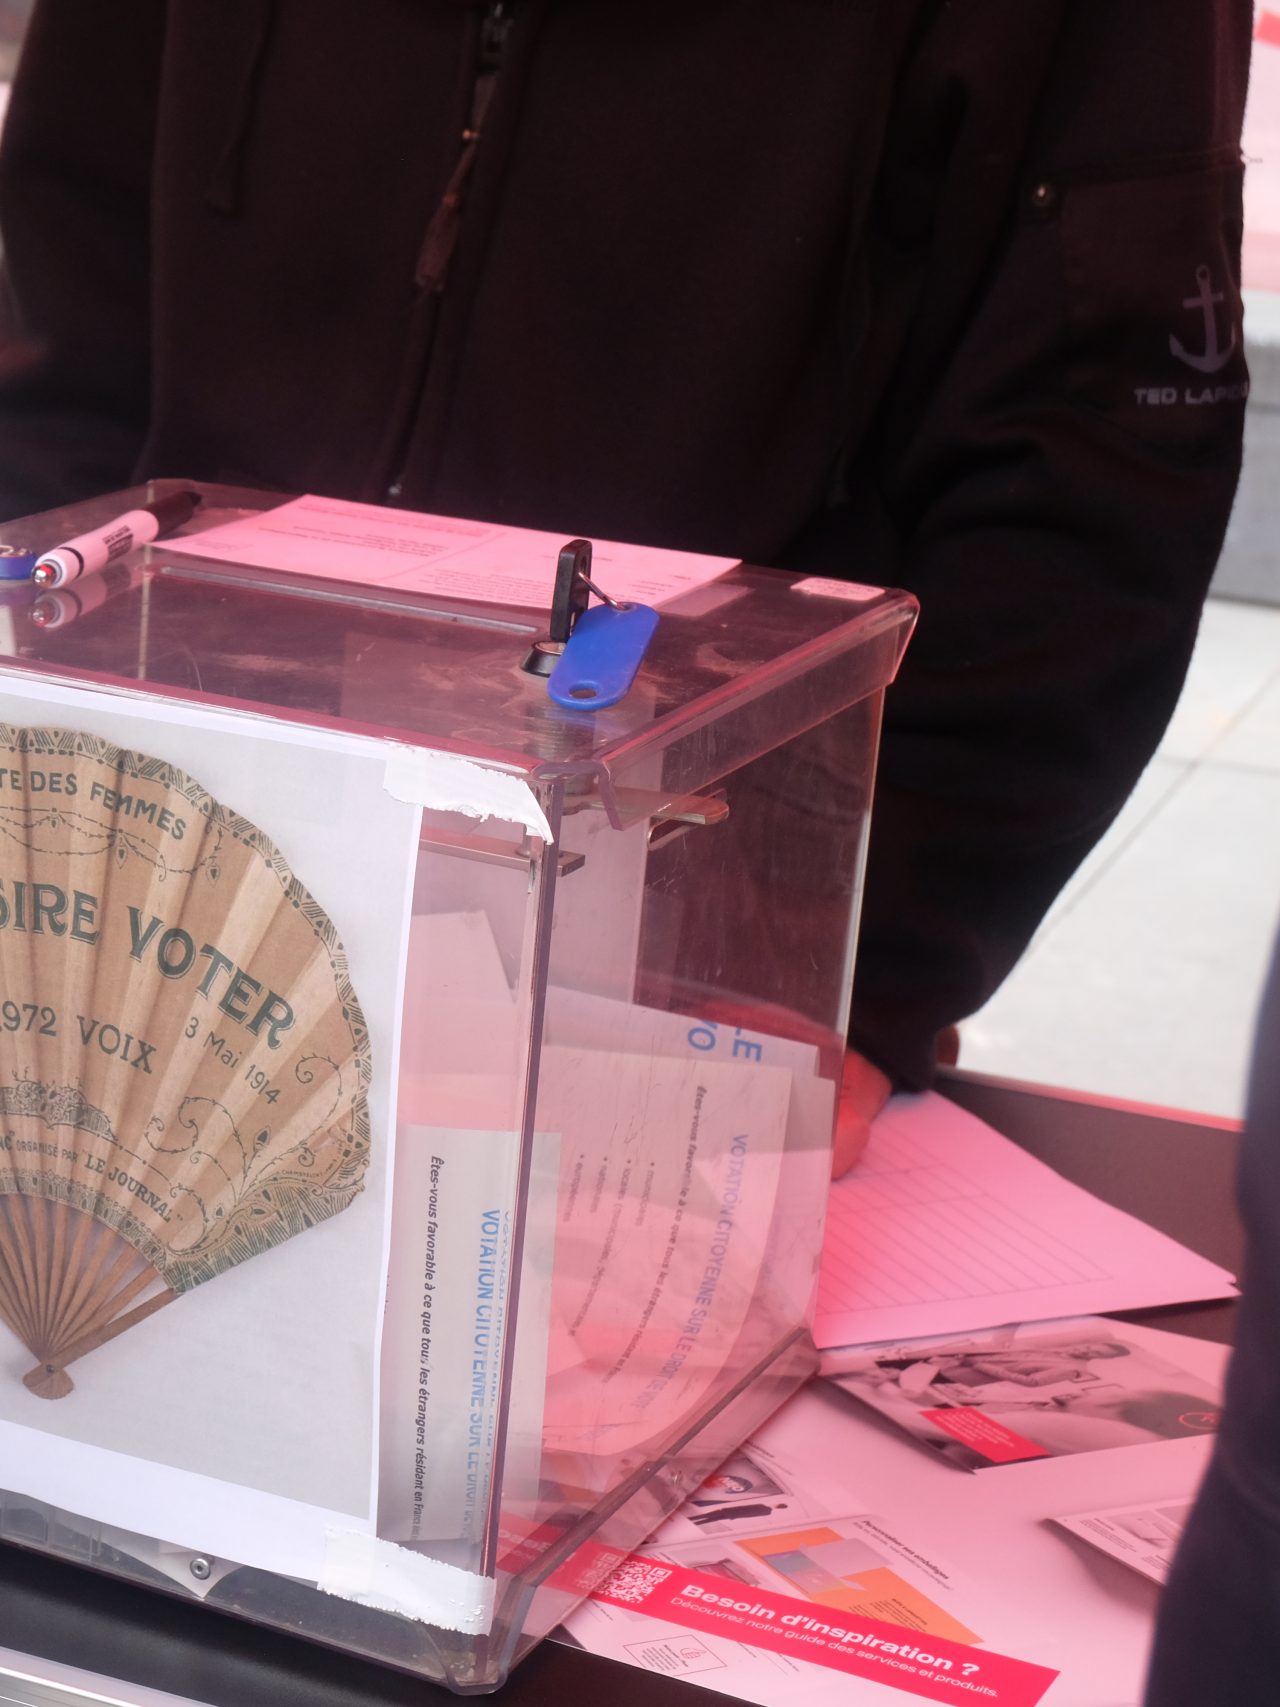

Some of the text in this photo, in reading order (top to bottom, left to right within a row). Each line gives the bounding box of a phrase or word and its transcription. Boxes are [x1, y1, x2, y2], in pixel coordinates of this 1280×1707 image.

[1134, 387, 1176, 405] TED
[30, 771, 78, 796] DES
[89, 781, 187, 841] FEMMES
[127, 905, 297, 1050] VOTER
[77, 1015, 157, 1074] VOIX
[184, 1016, 281, 1105] 3 Mai 1914
[61, 1150, 79, 1164] PAR
[720, 1134, 749, 1216] VOTATION
[428, 1155, 445, 1219] Êtes-vous
[425, 1220, 439, 1280] favorable
[669, 1224, 680, 1245] que
[424, 1282, 436, 1291] à
[696, 1219, 733, 1307] CITOYENNE
[420, 1311, 431, 1335] que
[423, 1294, 432, 1309] ce
[683, 1308, 708, 1335] SUR
[676, 1336, 697, 1353] LE
[419, 1366, 430, 1386] les
[415, 1388, 430, 1446] étrangers
[414, 1447, 427, 1489] résidant
[414, 1491, 423, 1502] en
[670, 1597, 998, 1697] Découvrez notre guide des services et produits.
[681, 1585, 776, 1619] Besoin
[781, 1615, 953, 1670] d'inspiration
[961, 1663, 980, 1676] ?
